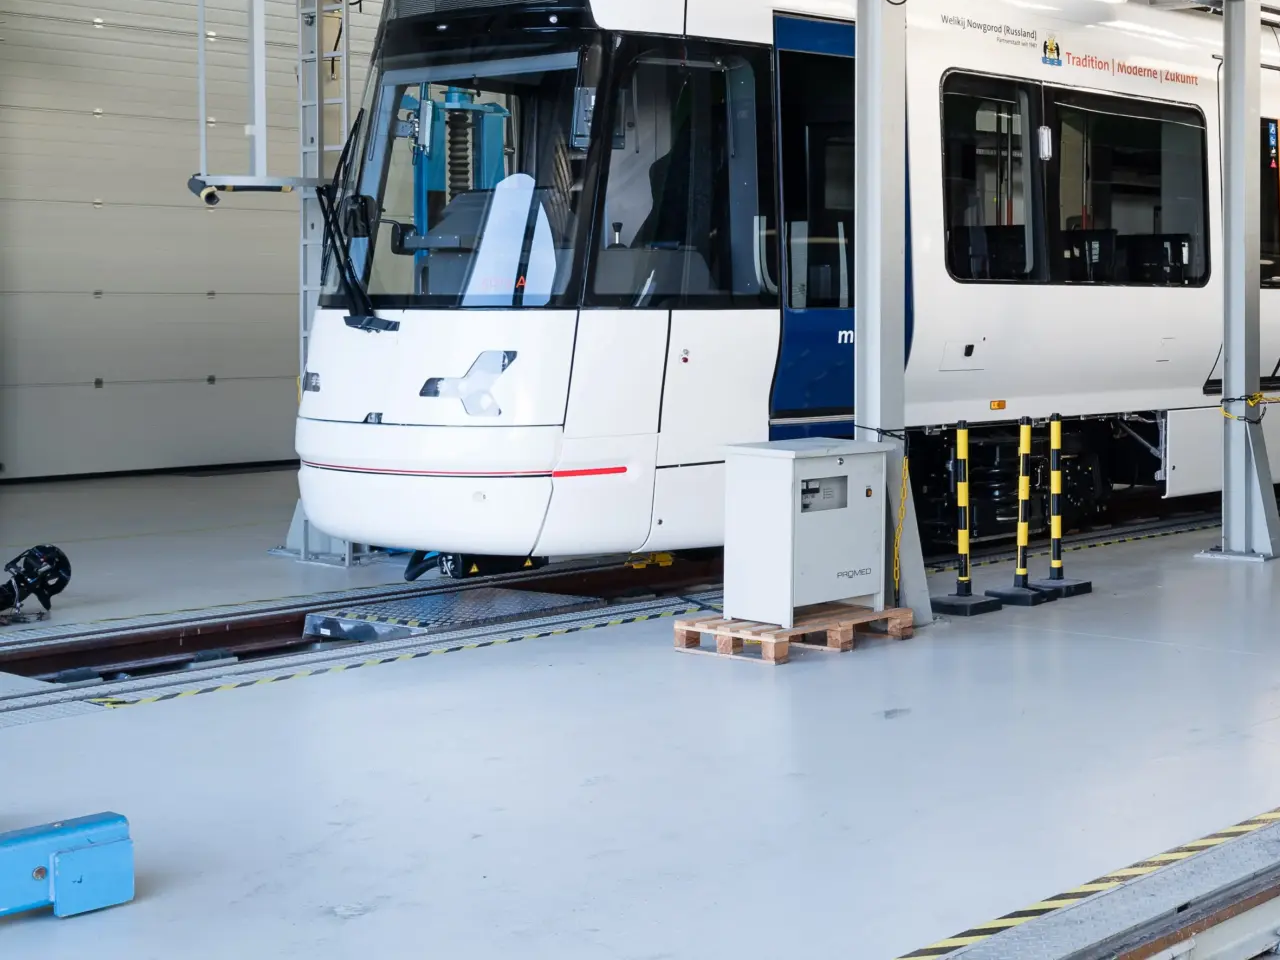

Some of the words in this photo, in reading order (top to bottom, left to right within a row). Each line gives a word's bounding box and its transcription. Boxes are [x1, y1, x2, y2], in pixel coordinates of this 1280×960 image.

[941, 14, 966, 29] Welikij
[967, 19, 1003, 33] Nowgorod
[1003, 24, 1037, 41] (Russland)
[1065, 52, 1110, 71] Tradition
[1117, 62, 1158, 79] Moderne
